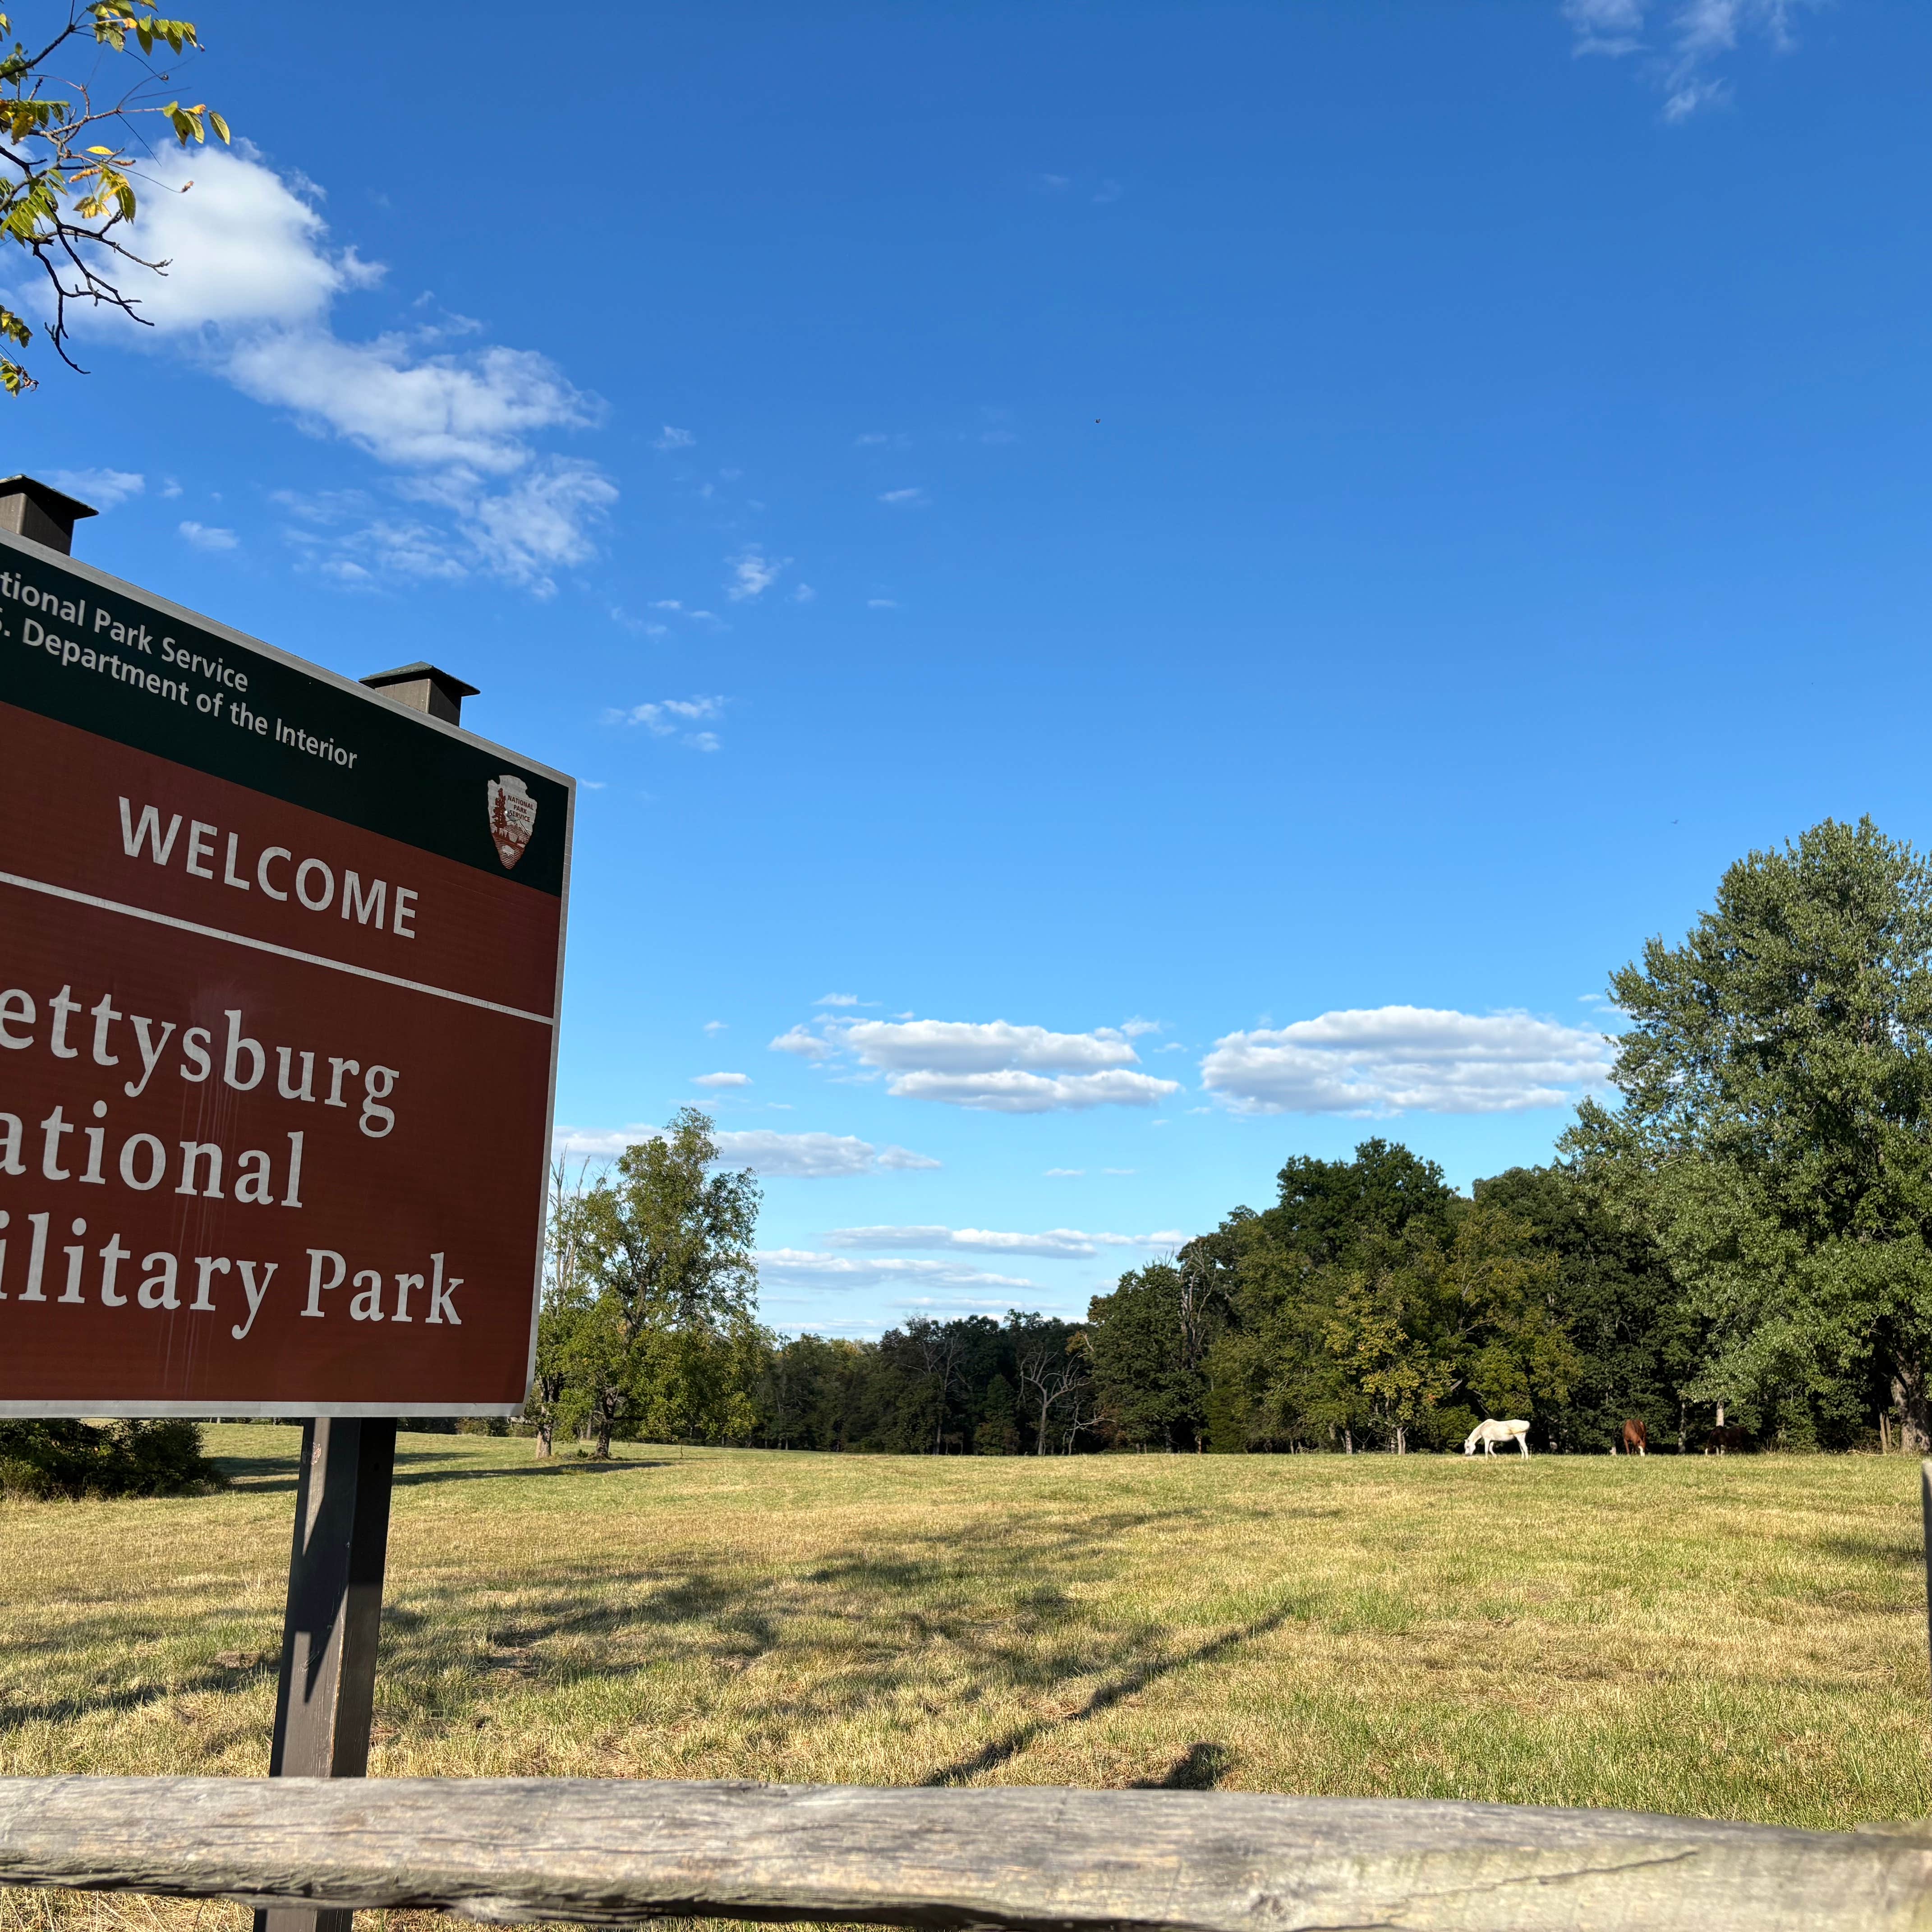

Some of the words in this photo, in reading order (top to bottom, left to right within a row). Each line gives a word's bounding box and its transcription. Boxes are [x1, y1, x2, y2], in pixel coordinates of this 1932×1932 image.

[22, 617, 189, 706] Department
[196, 692, 224, 718] of
[229, 702, 268, 736] the
[275, 718, 359, 769] Interior
[94, 607, 153, 655] Park
[161, 637, 248, 693] Service
[508, 795, 534, 810] NATIONAL
[509, 810, 530, 822] SERVICE
[513, 805, 527, 814] PARK
[118, 796, 419, 939] WELCOME
[0, 984, 400, 1138] ettysburg
[0, 1099, 304, 1209] ational
[300, 1248, 465, 1325] Park
